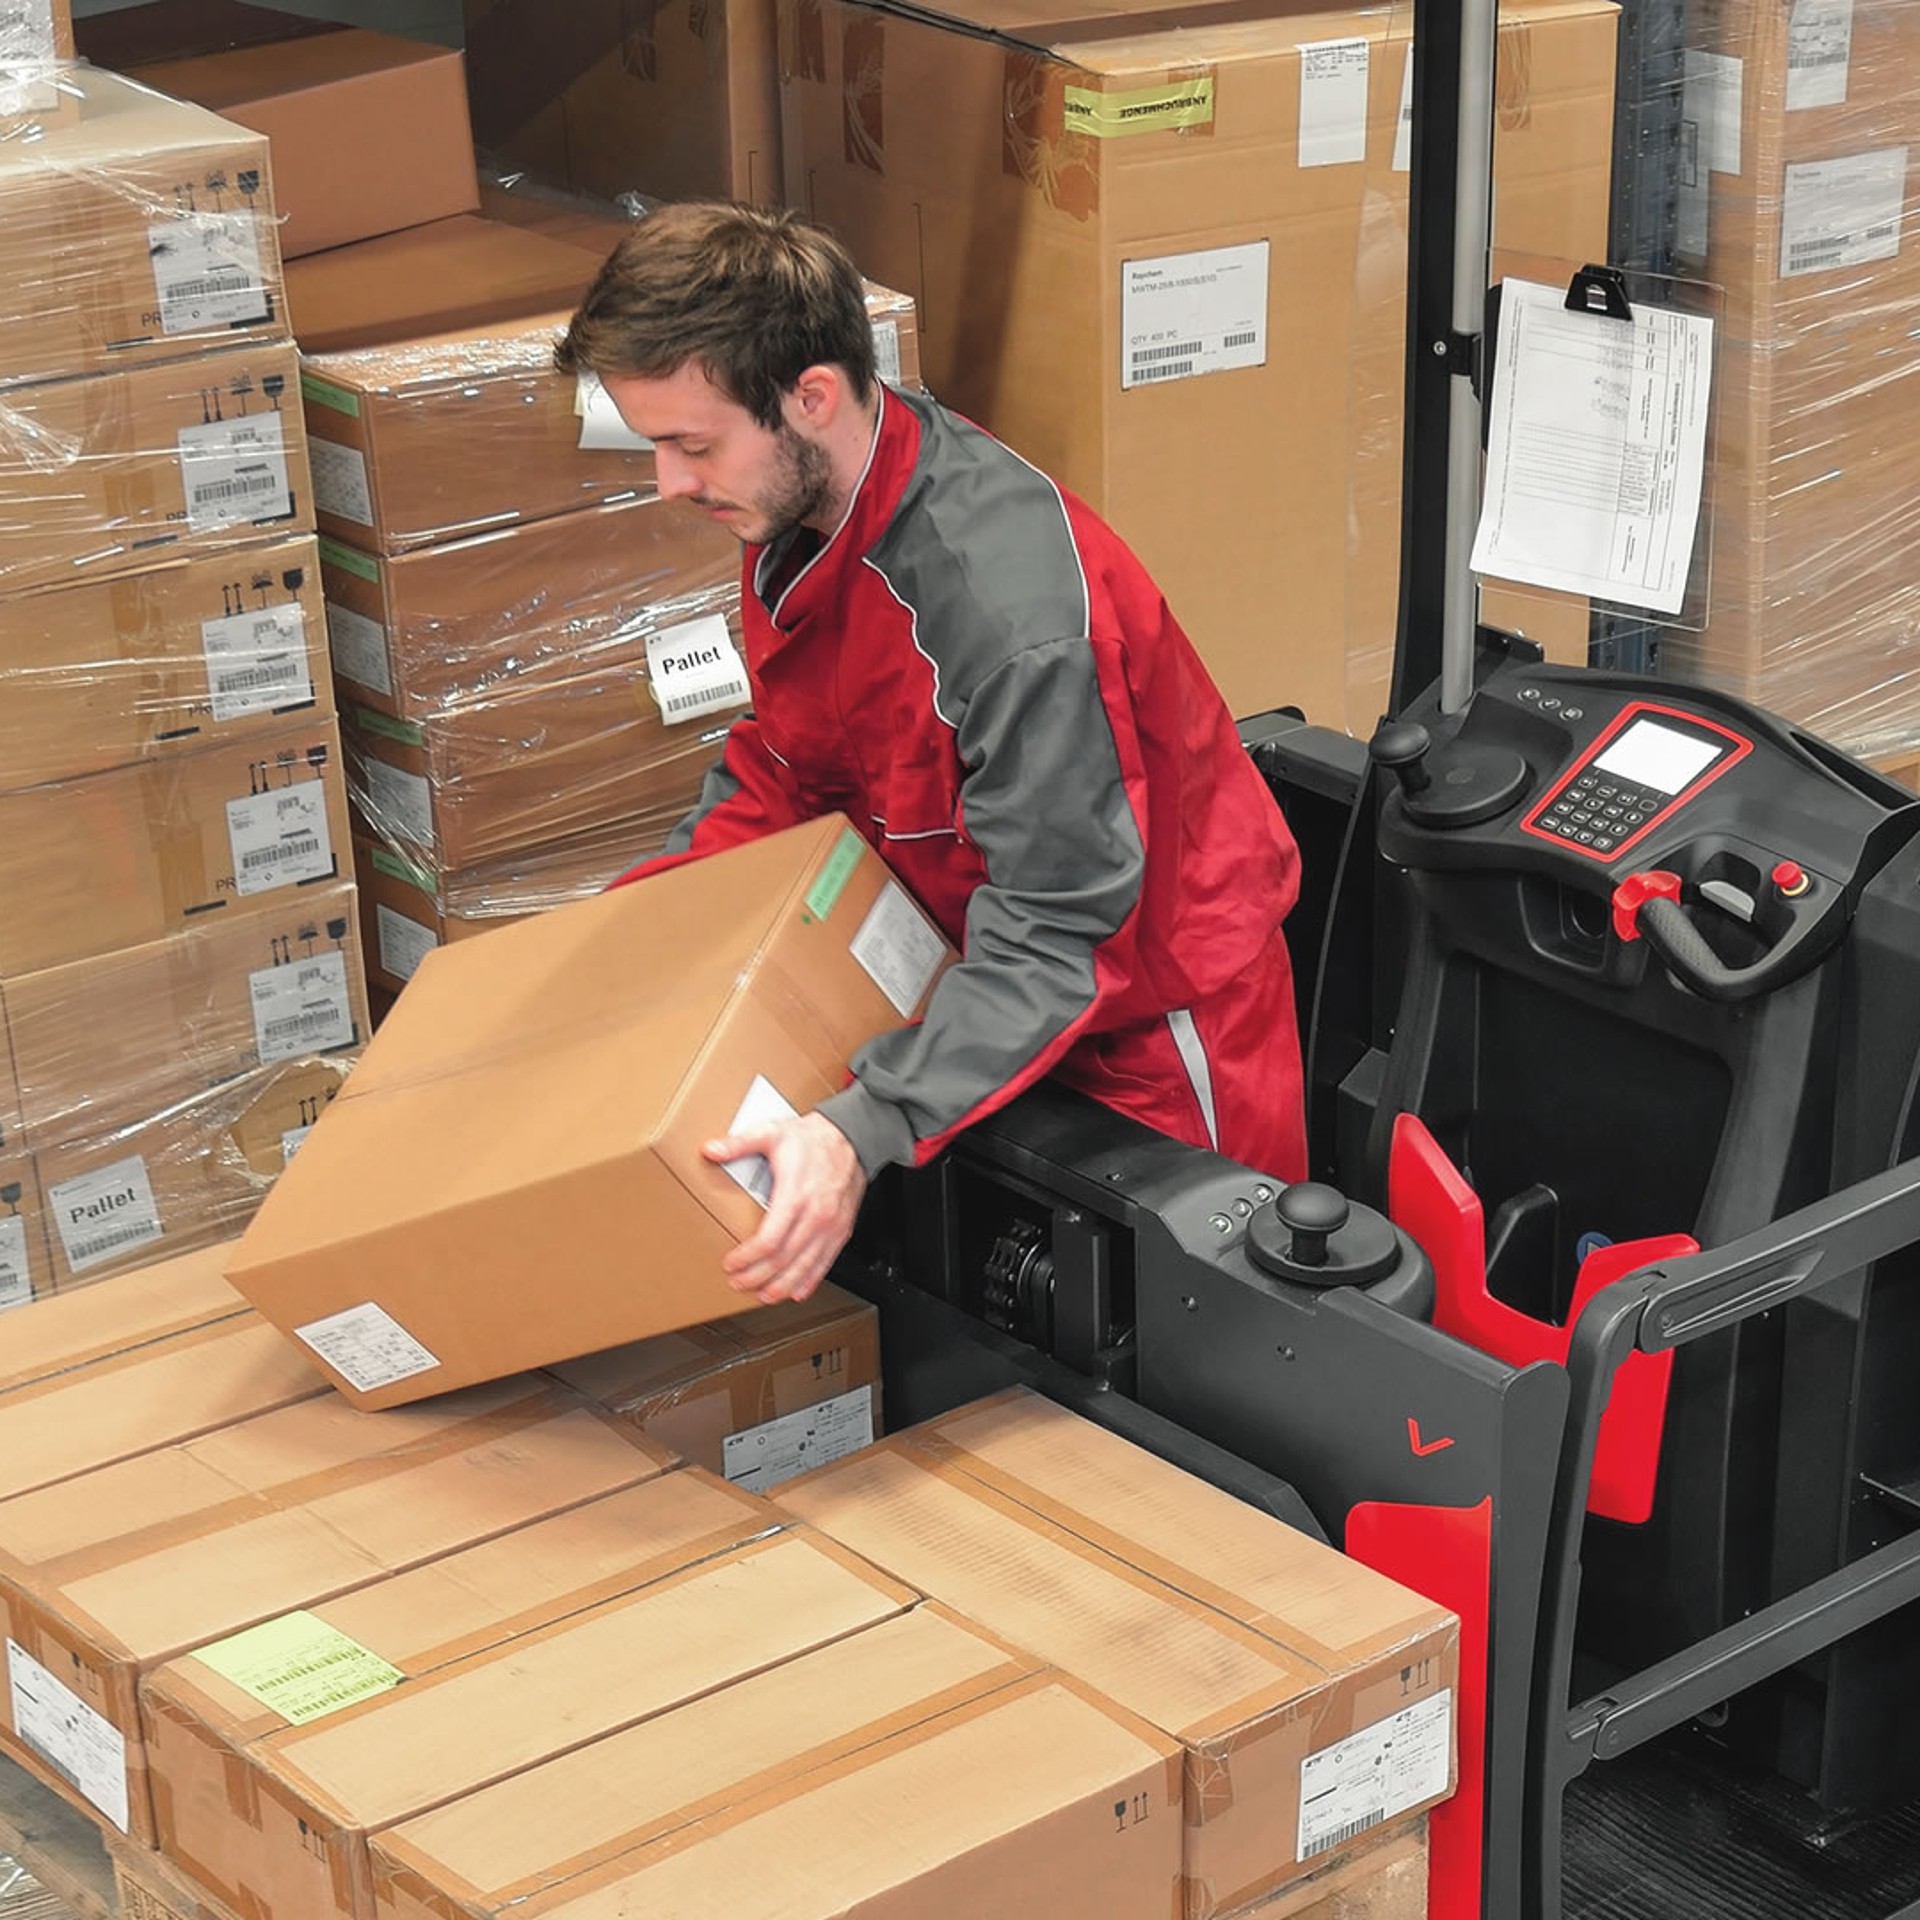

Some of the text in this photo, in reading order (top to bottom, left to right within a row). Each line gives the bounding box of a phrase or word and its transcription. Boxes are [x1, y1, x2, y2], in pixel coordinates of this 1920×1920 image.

[1120, 96, 1207, 118] ANBRUCHMENGE
[662, 646, 722, 675] Pallet
[70, 1187, 136, 1224] Pallet
